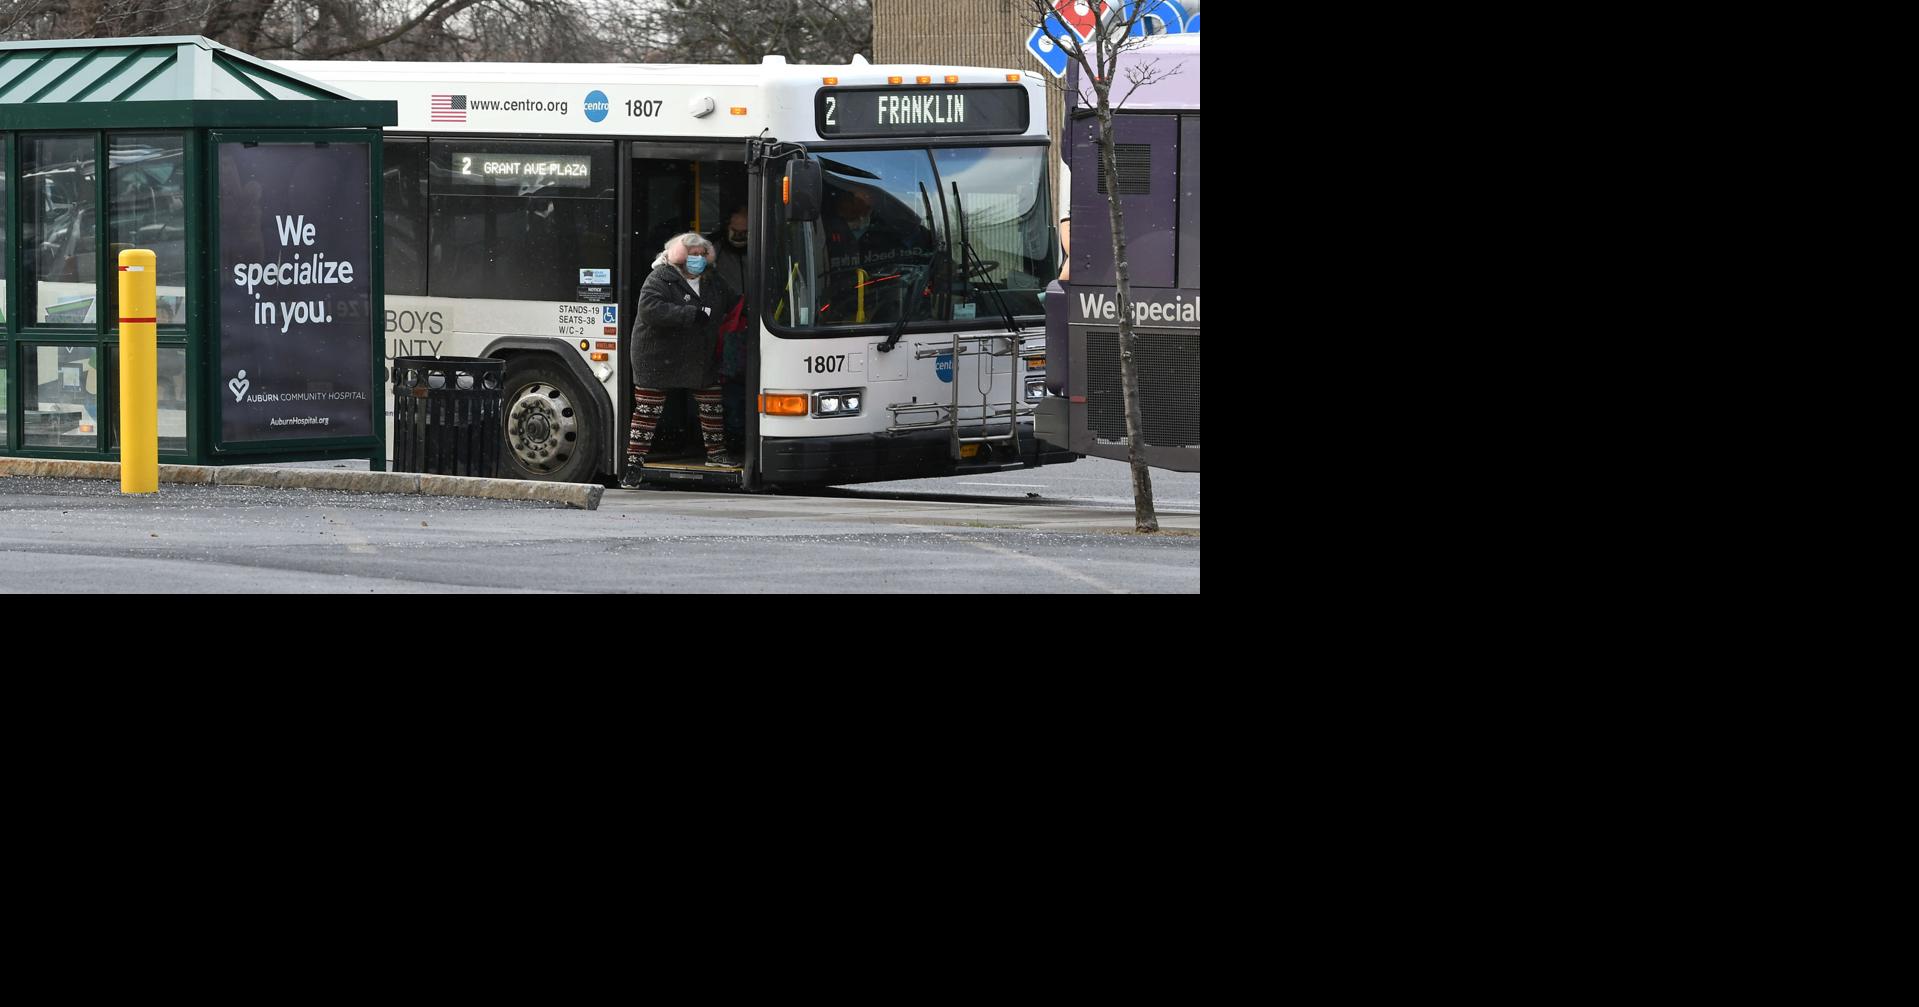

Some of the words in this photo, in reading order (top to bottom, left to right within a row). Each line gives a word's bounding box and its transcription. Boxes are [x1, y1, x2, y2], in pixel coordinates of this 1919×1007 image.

[470, 99, 568, 115] www.centro.org
[583, 101, 609, 111] centro
[625, 100, 663, 117] 1807
[825, 96, 836, 126] 2
[878, 94, 964, 124] FRANKLIN
[462, 157, 472, 175] 2
[484, 162, 521, 174] GRANT
[523, 163, 547, 175] AVE
[549, 163, 588, 176] PLAZA
[275, 215, 316, 246] We
[233, 252, 354, 295] specialize
[254, 292, 276, 325] in
[280, 300, 333, 333] you.
[559, 305, 600, 315] STANDS-19
[1079, 292, 1116, 320] We
[558, 315, 596, 325] SEATS-38
[558, 326, 584, 335] W/C-2
[803, 354, 846, 374] 1807
[936, 360, 953, 370] cent
[246, 393, 279, 403] AUBURN
[280, 392, 327, 401] COMMUNITY
[328, 391, 366, 400] HOSPITAL
[270, 416, 329, 426] AuburnHospital.org
